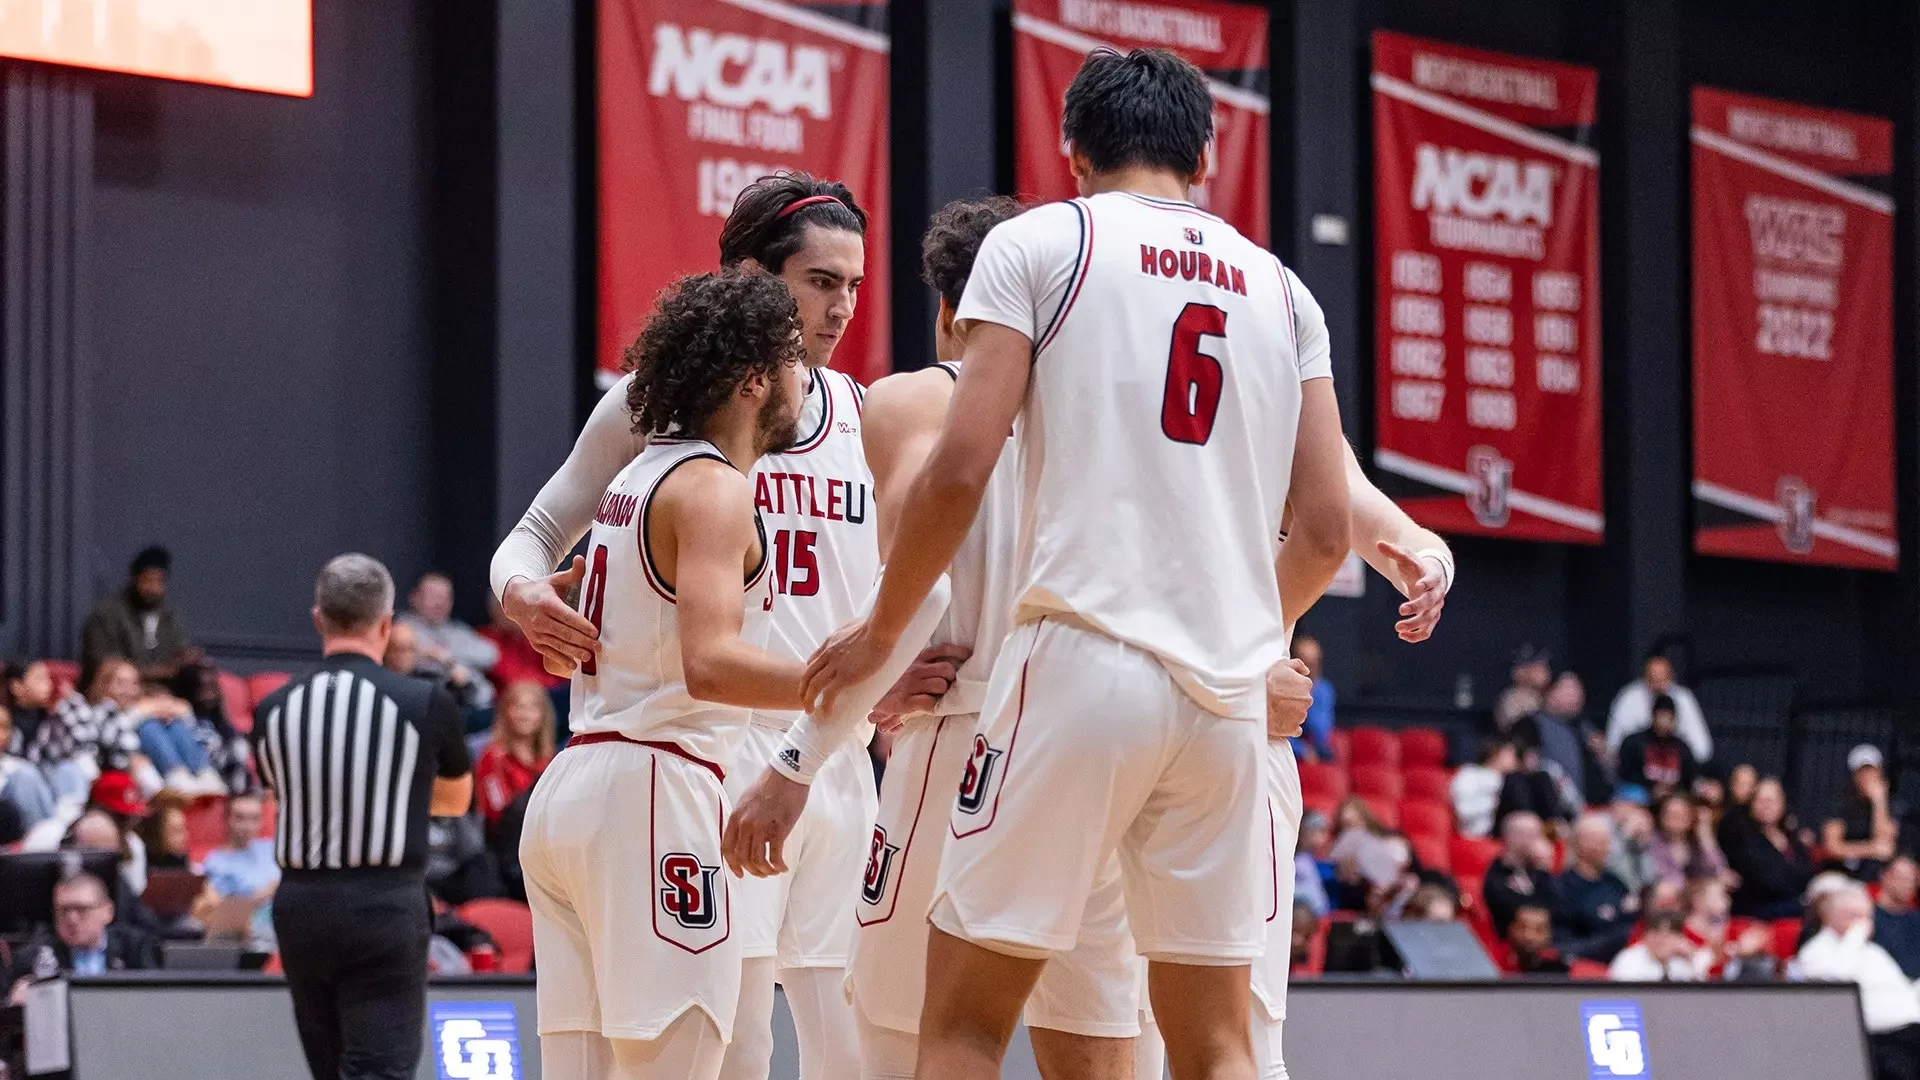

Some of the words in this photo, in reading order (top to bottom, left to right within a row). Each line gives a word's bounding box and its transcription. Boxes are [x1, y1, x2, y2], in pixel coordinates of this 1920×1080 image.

[649, 24, 832, 119] NCAA
[687, 104, 745, 149] FINAL
[747, 112, 804, 153] FOUR
[1411, 142, 1554, 229] NCAA
[1139, 243, 1248, 297] HOURAN
[1756, 303, 1835, 360] 2022
[1160, 301, 1229, 447] 6
[754, 471, 866, 525] ATTLEU
[773, 529, 820, 597] 15
[778, 751, 801, 773] adidas
[660, 852, 721, 929] SU
